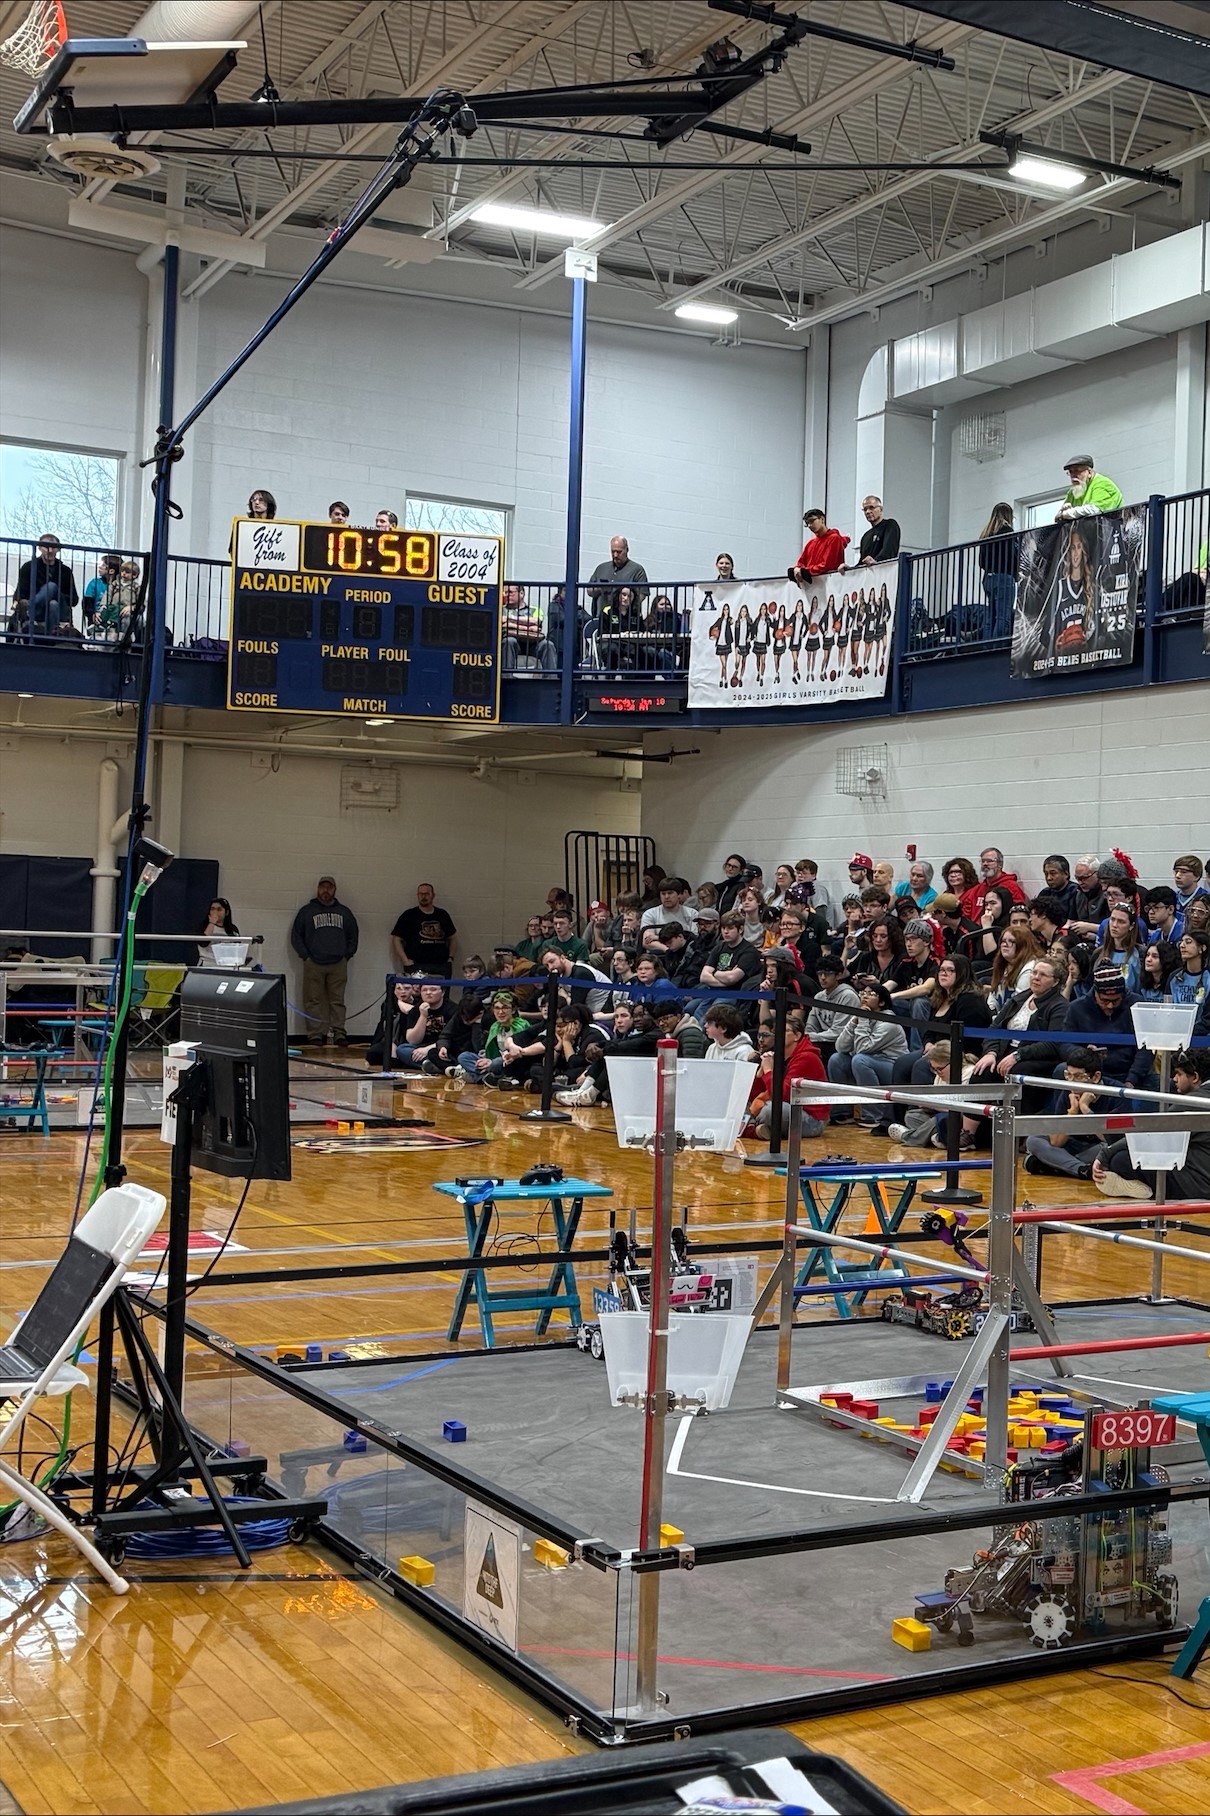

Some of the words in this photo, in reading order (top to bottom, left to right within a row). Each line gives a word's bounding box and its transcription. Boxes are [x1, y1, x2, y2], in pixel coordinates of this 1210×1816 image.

[252, 526, 282, 546] Gift
[255, 547, 287, 566] from
[327, 531, 430, 575] 10:58
[442, 539, 481, 560] Class
[483, 545, 497, 567] of
[447, 564, 488, 581] 2004
[239, 572, 333, 595] ACADEMY
[345, 589, 391, 604] PERIOD
[428, 585, 488, 605] GUEST
[237, 640, 279, 654] FOULS
[321, 645, 369, 660] PLAYER
[378, 648, 411, 662] FOUL
[452, 652, 493, 667] FOULS
[1057, 654, 1079, 667] BEARS
[1081, 648, 1122, 664] BASKETBALL
[235, 692, 278, 707] SCORE
[800, 690, 826, 698] VARSITY
[829, 685, 865, 696] BASETBALL
[343, 698, 387, 713] MATCH
[451, 704, 492, 718] SCORE
[1101, 1414, 1169, 1446] 8397
